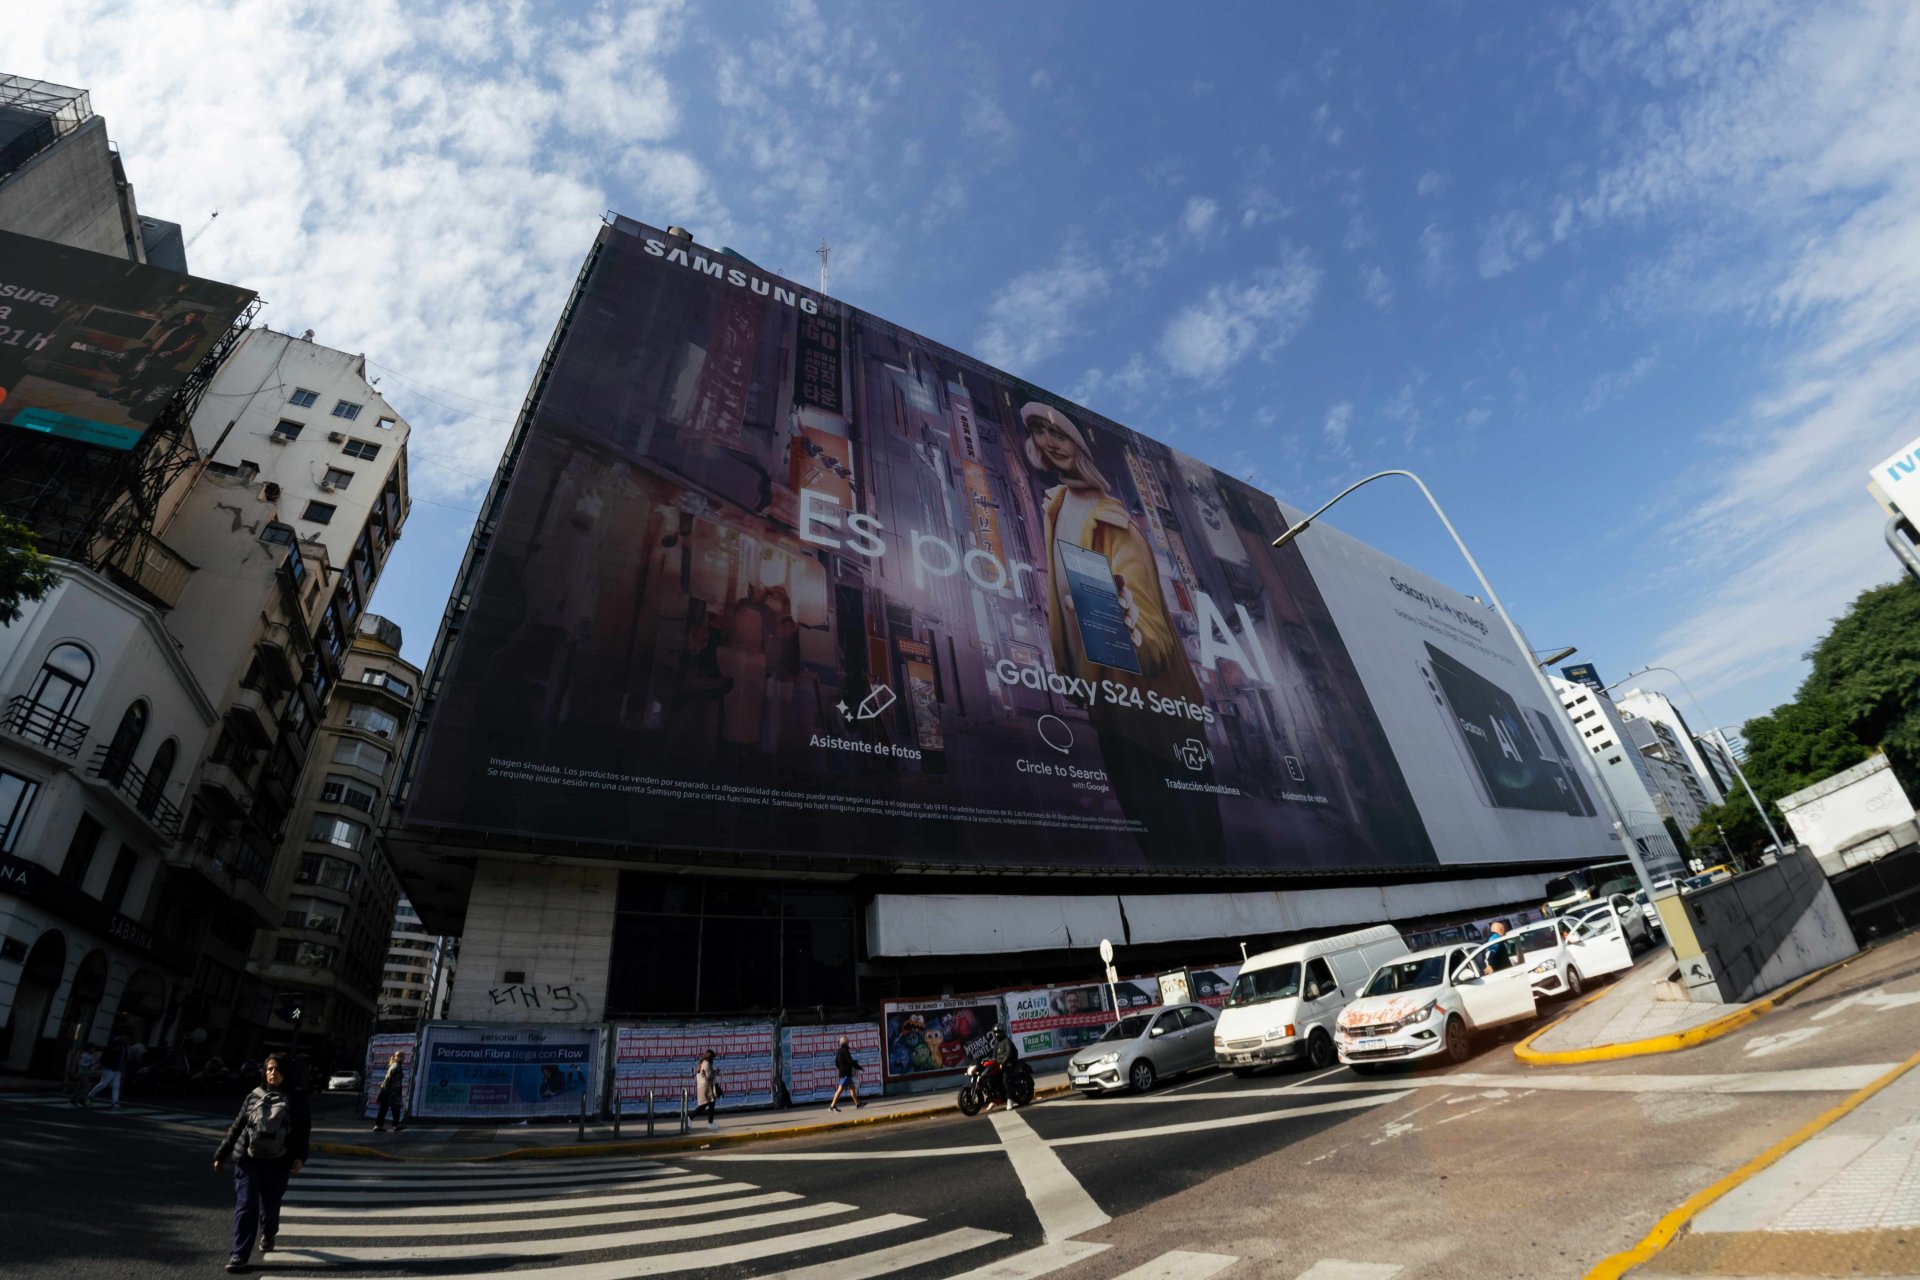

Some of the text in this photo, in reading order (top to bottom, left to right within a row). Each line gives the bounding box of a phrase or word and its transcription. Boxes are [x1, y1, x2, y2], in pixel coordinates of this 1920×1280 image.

[644, 238, 818, 315] SAMSUNG
[0, 282, 60, 308] sura
[800, 487, 1032, 598] Es por
[1390, 576, 1432, 610] Galaxy
[1196, 590, 1277, 685] AI
[996, 658, 1214, 724] Galaxy S24 Series
[1460, 718, 1488, 742] Galaxy
[1489, 714, 1524, 763] AI
[810, 734, 922, 760] Asistente de fotos
[490, 756, 522, 768] Imagen
[523, 761, 562, 774] simulada.
[564, 767, 578, 776] Los
[580, 769, 619, 781] productos
[621, 774, 630, 782] se
[631, 776, 660, 785] venden
[661, 779, 674, 787] por
[675, 780, 710, 790] separado.
[722, 784, 770, 796] disponibilidad
[781, 790, 804, 799] colores
[806, 793, 826, 802] puede
[1016, 759, 1108, 782] Circle to Search
[488, 768, 498, 776] Se
[500, 770, 534, 781] requiere
[536, 774, 561, 784] iniciar
[562, 778, 588, 788] sesión
[590, 781, 600, 789] en
[618, 785, 645, 794] cuenta
[646, 787, 682, 798] Samsung
[683, 791, 700, 799] para
[701, 793, 726, 801] ciertas
[727, 795, 761, 804] funciones
[772, 800, 802, 809] Samsung
[814, 802, 828, 810] hace
[830, 804, 855, 812] ninguna
[885, 808, 912, 817] seguridad
[1086, 782, 1110, 794] Google
[1165, 778, 1240, 796] Traducción simultánea
[110, 916, 153, 950] SABRINA
[1017, 998, 1033, 1010] ACÁ
[1018, 1008, 1049, 1020] SUELDO
[481, 1034, 517, 1042] personal
[964, 1036, 988, 1056] INTENSA
[1024, 1034, 1050, 1045] Tasa 0%
[437, 1047, 583, 1061] Personal Fibra llega con Flow
[971, 1046, 991, 1060] MENTE
